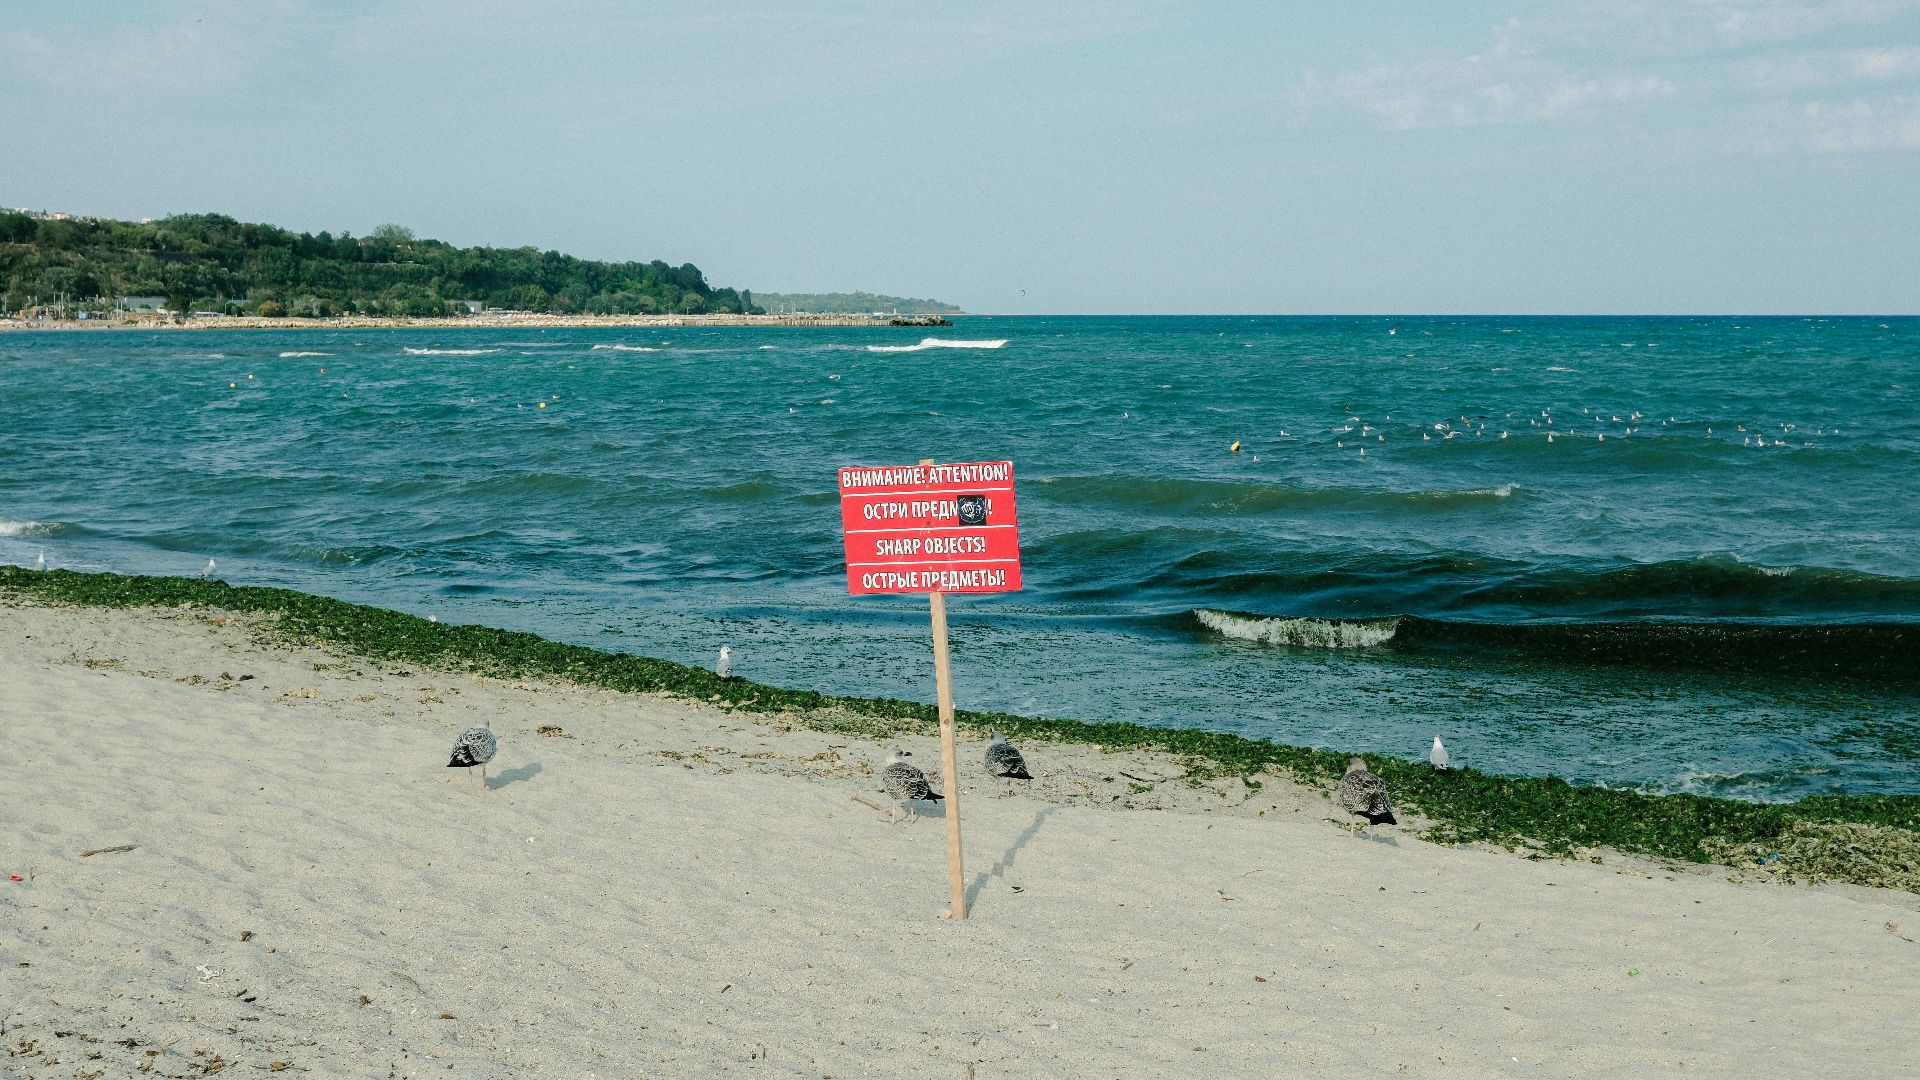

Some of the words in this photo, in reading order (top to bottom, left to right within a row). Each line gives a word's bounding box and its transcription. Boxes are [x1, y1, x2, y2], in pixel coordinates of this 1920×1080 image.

[842, 467, 926, 488] ВНИМАНИЕ!
[929, 463, 1009, 484] ATTENTION!
[863, 502, 908, 520] ОСТРИ
[911, 498, 993, 520] ПРЕДМ!
[876, 538, 921, 556] SHARP
[924, 536, 986, 554] OBJECTS!
[862, 572, 919, 589] ОСТРЫЕ
[921, 569, 1006, 590] ПРЕДМЕТЫ!
